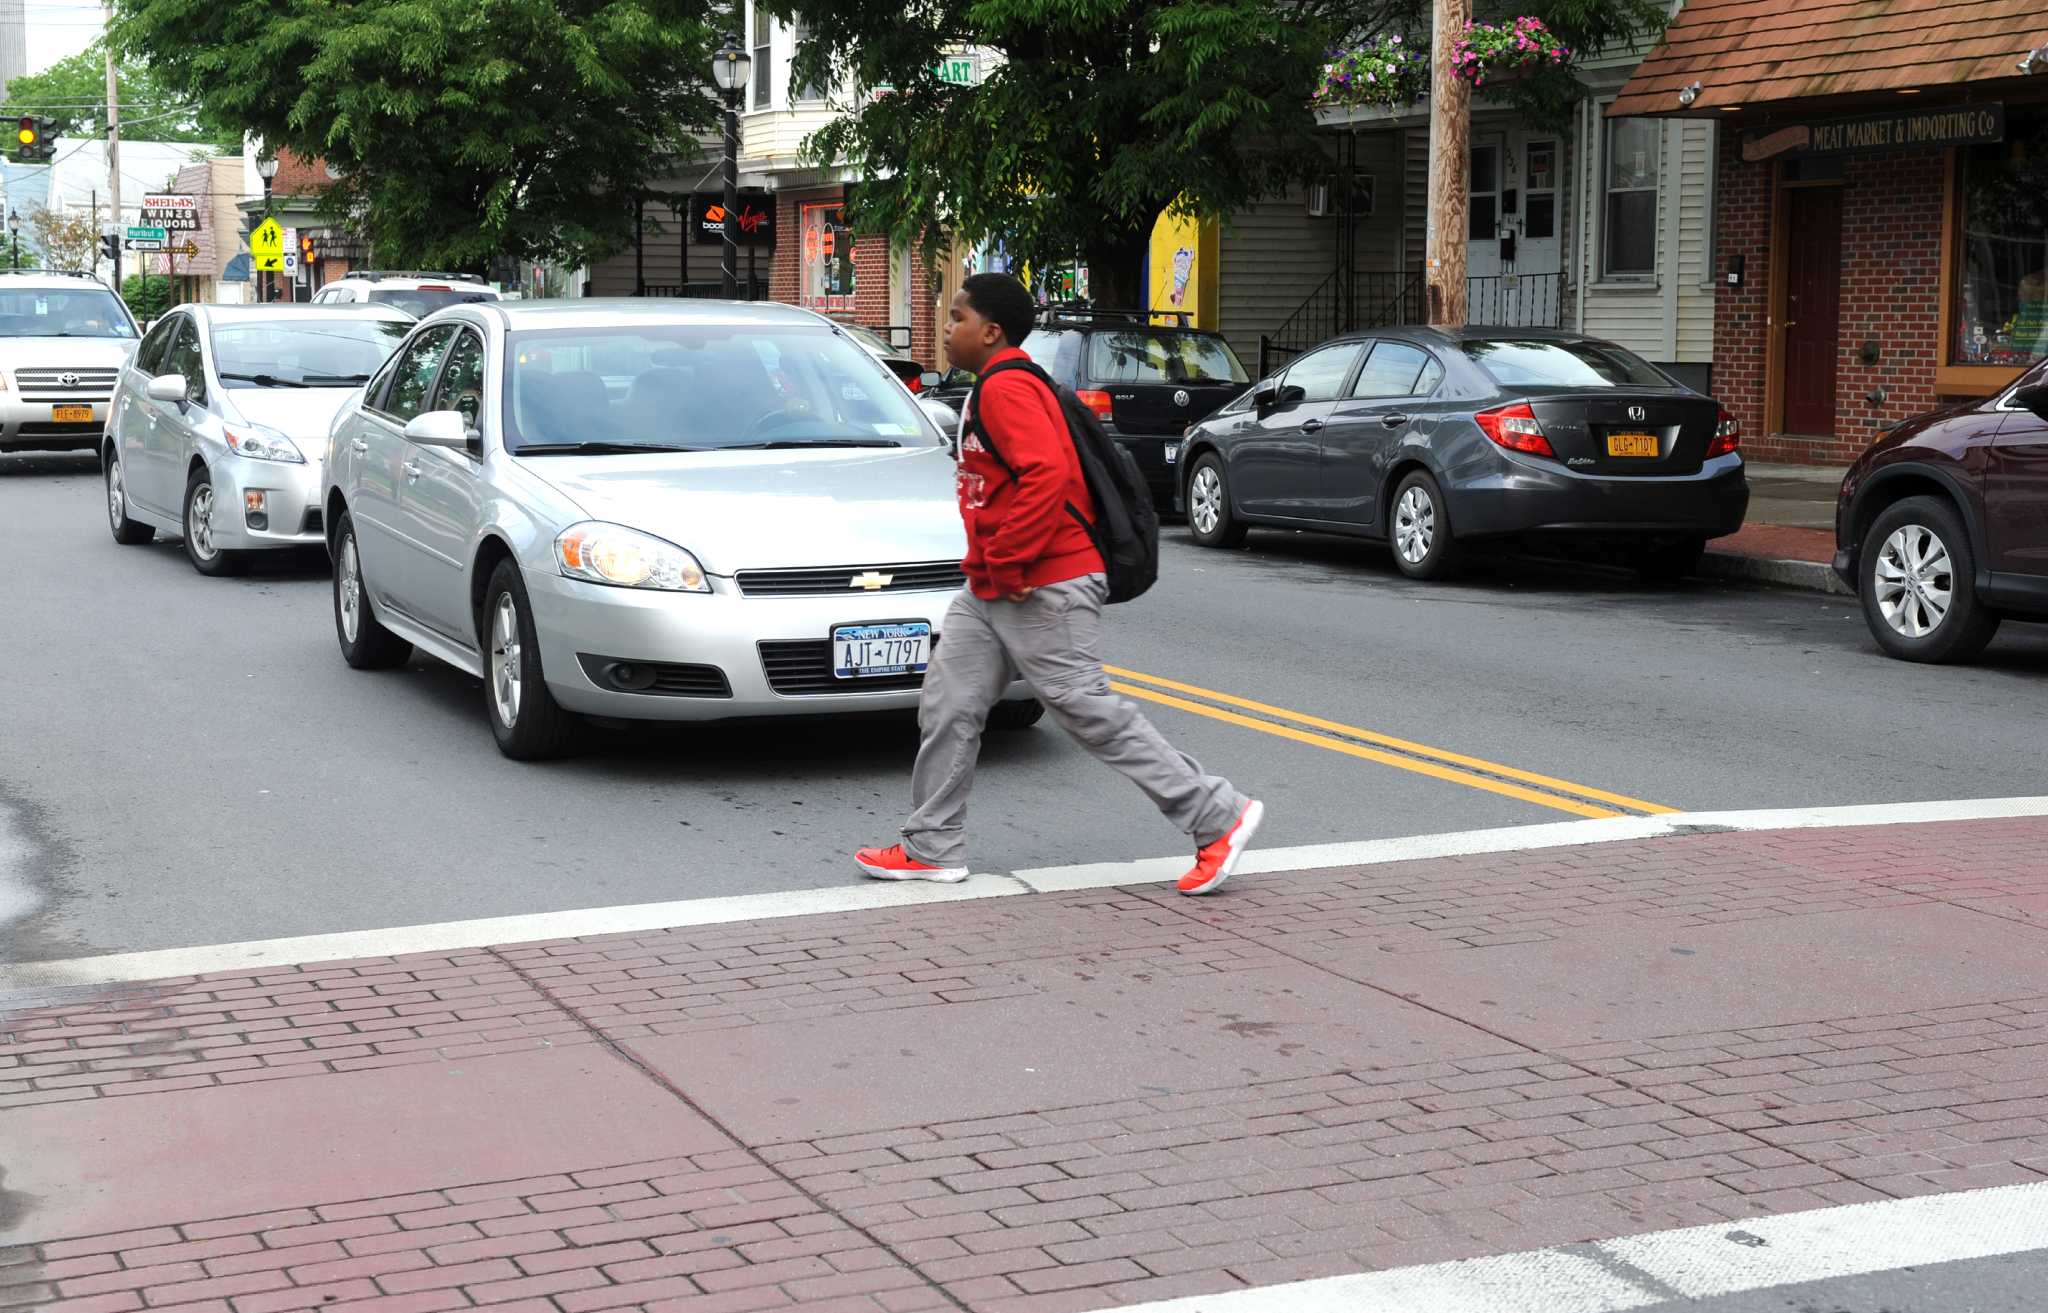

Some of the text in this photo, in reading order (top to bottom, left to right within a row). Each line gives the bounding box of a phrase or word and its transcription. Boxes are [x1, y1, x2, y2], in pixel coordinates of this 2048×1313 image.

[1813, 126, 1845, 150] MEAT
[1847, 120, 1893, 146] MARKET
[1895, 119, 1905, 143] &
[1907, 113, 1976, 142] IMPORTING
[147, 209, 192, 218] WINES
[141, 218, 196, 229] LIQUORS
[859, 628, 907, 640] NEW YORK
